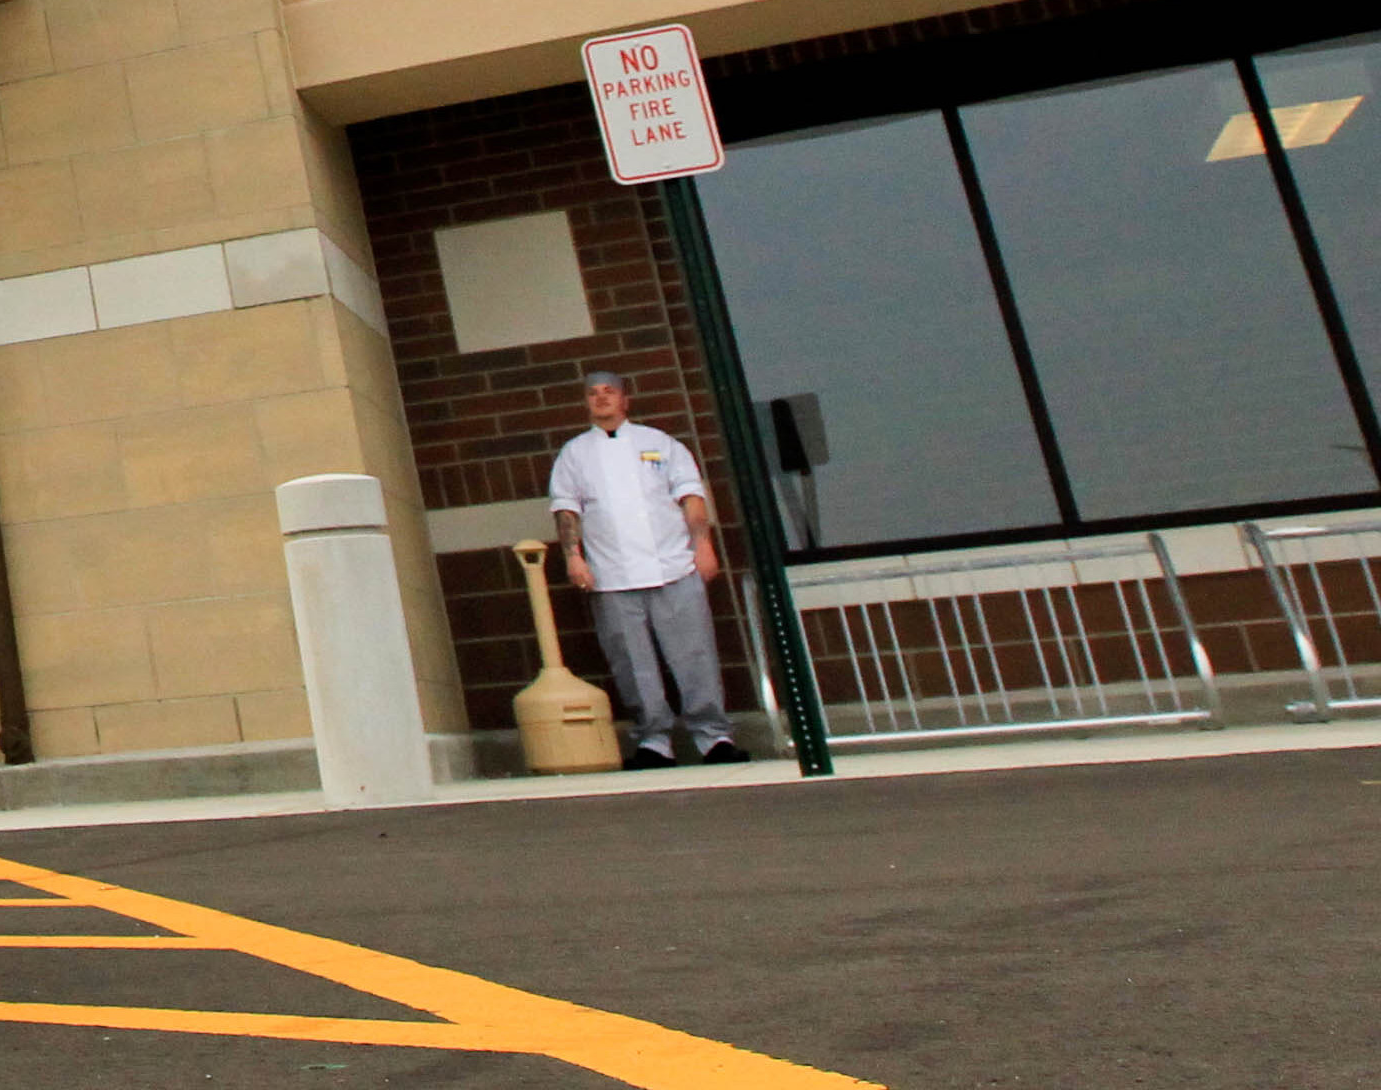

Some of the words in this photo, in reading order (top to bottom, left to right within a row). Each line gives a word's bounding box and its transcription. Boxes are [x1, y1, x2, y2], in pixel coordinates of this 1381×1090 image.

[619, 45, 659, 74] NO
[602, 70, 691, 100] PARKING
[629, 97, 676, 121] FIRE
[630, 121, 687, 146] LANE
